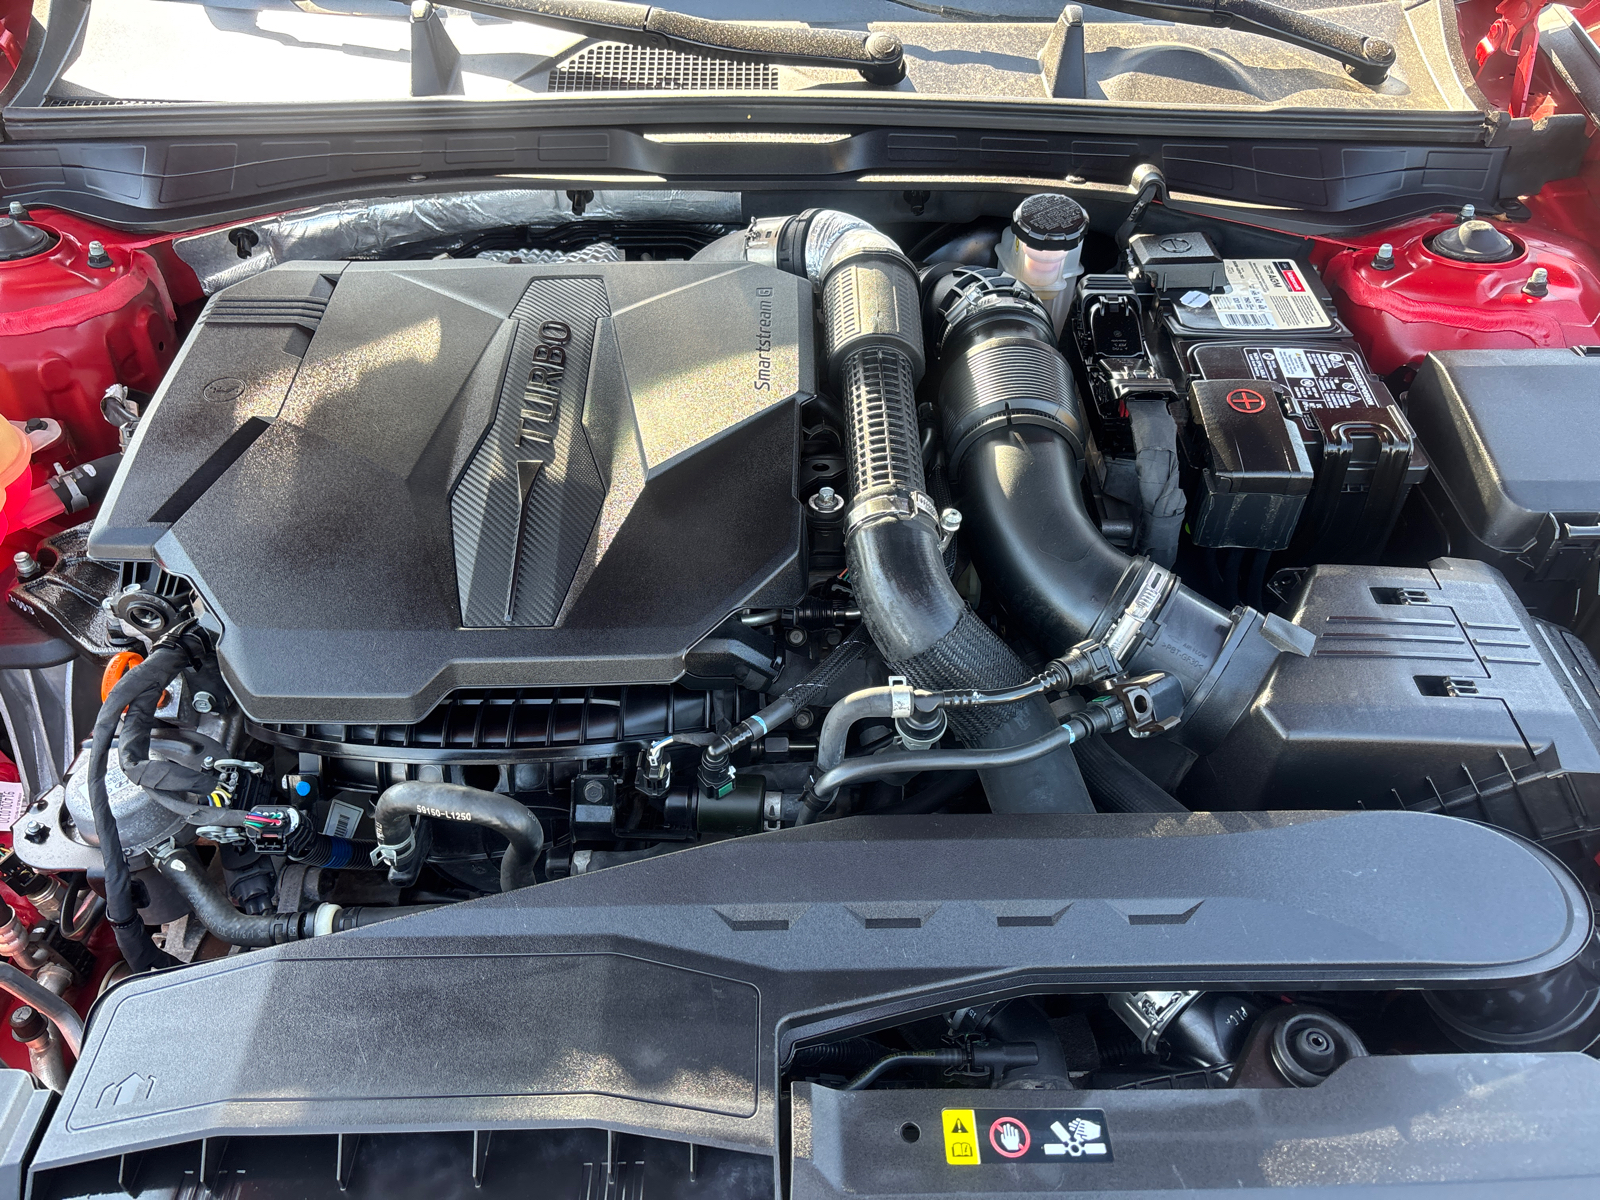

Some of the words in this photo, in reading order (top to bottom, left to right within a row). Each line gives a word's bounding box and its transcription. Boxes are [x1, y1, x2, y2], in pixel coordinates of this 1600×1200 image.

[1268, 274, 1282, 288] AGM
[754, 301, 772, 392] Smartstream
[514, 320, 572, 447] TURBO
[416, 804, 472, 821] 59150-L1250
